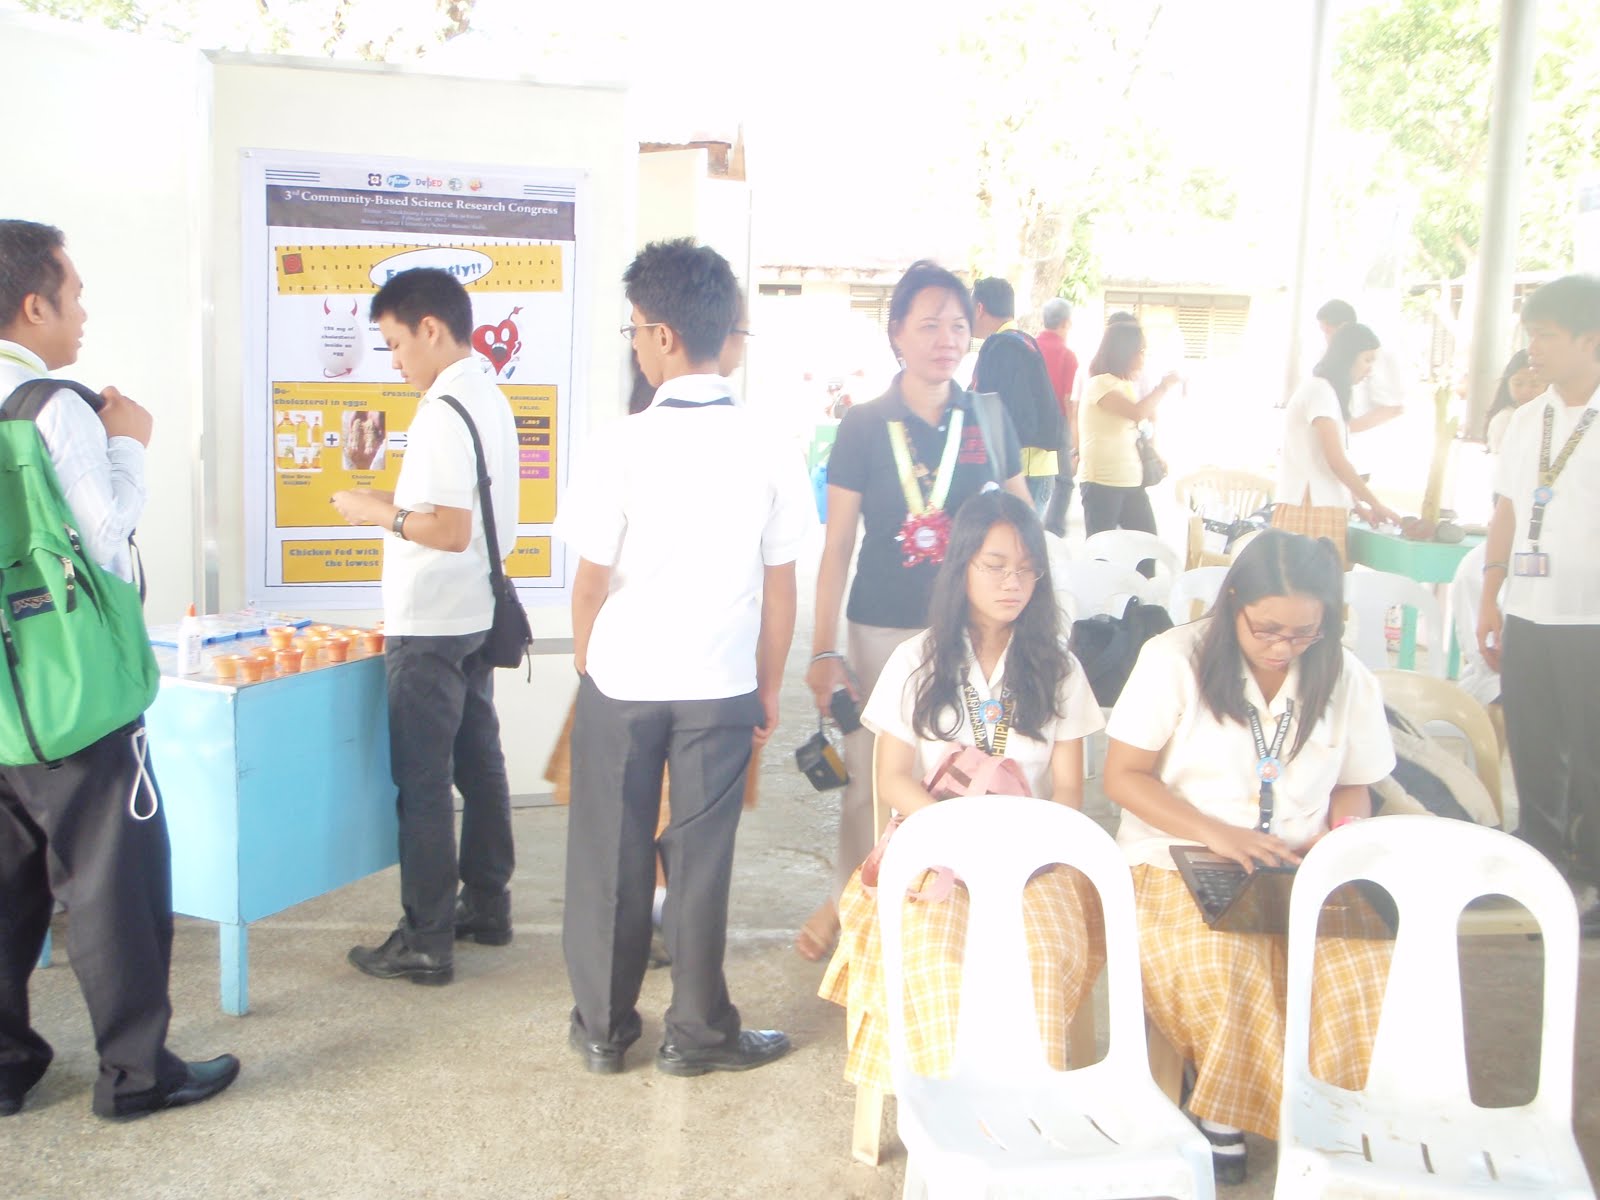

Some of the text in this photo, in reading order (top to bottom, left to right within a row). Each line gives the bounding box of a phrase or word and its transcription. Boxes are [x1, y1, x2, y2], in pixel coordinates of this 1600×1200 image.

[416, 176, 443, 188] DepED
[284, 189, 558, 216] 3rd Community-Based Science Research Congress
[289, 548, 332, 556] Chicken
[356, 548, 379, 556] with
[325, 559, 379, 567] the lowest
